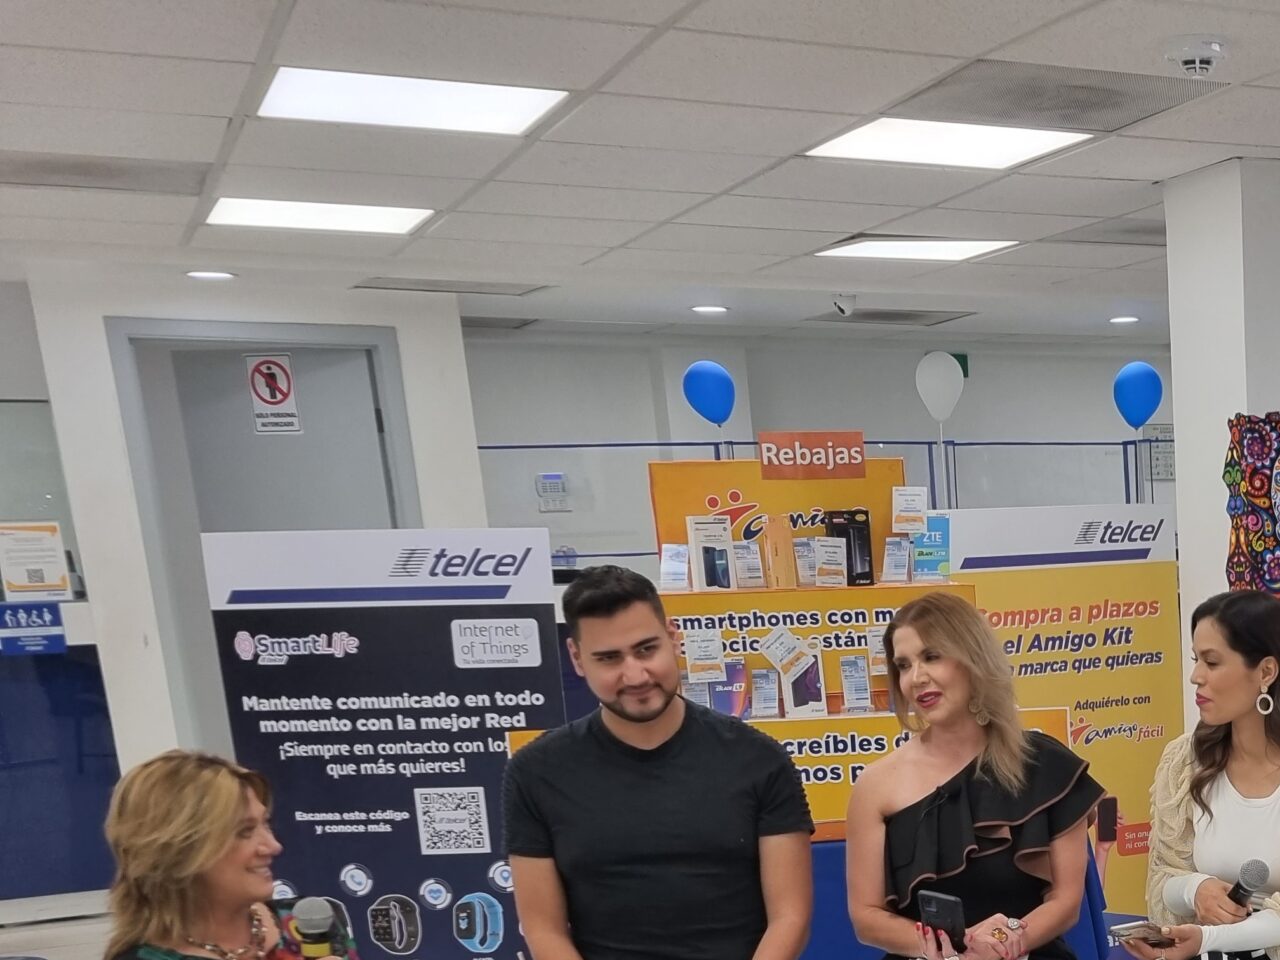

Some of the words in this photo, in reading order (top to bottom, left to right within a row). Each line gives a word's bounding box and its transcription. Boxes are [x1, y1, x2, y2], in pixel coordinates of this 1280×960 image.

[761, 442, 863, 470] Rebajas
[1100, 519, 1164, 544] telcel
[428, 547, 533, 577] telcel
[828, 610, 867, 624] con
[978, 604, 1062, 629] ompra
[1069, 606, 1081, 622] a
[1088, 599, 1160, 624] plazos
[458, 623, 520, 645] Internet
[1003, 635, 1022, 654] el
[1027, 631, 1097, 652] Amigo
[1103, 626, 1133, 646] Kit
[256, 632, 358, 658] SmartLife
[461, 642, 476, 657] of
[478, 641, 529, 658] Things
[1018, 660, 1069, 677] marca
[1072, 656, 1101, 674] que
[1105, 652, 1162, 671] quieras
[242, 695, 333, 711] Mantente
[336, 692, 461, 710] comunicado
[466, 694, 493, 707] en
[494, 690, 545, 707] todo
[1074, 697, 1130, 712] Adquiérelo
[1133, 695, 1151, 706] con
[259, 717, 353, 733] momento
[355, 717, 392, 732] con
[396, 715, 416, 731] la
[420, 714, 481, 734] mejor
[485, 712, 526, 729] Red
[1084, 723, 1137, 745] amigo
[1137, 725, 1164, 743] fácil
[278, 741, 350, 760] ¡Siempre
[352, 742, 374, 755] en
[376, 740, 449, 754] contacto
[452, 740, 484, 752] con
[326, 761, 357, 778] que
[360, 758, 396, 775] más
[398, 757, 466, 776] quieres!
[294, 811, 342, 821] Escanea
[343, 810, 368, 821] este
[368, 808, 410, 823] código
[315, 824, 323, 835] y
[324, 823, 369, 833] conoce
[370, 821, 393, 833] más
[1124, 832, 1136, 841] Sin
[1126, 841, 1134, 849] ni
